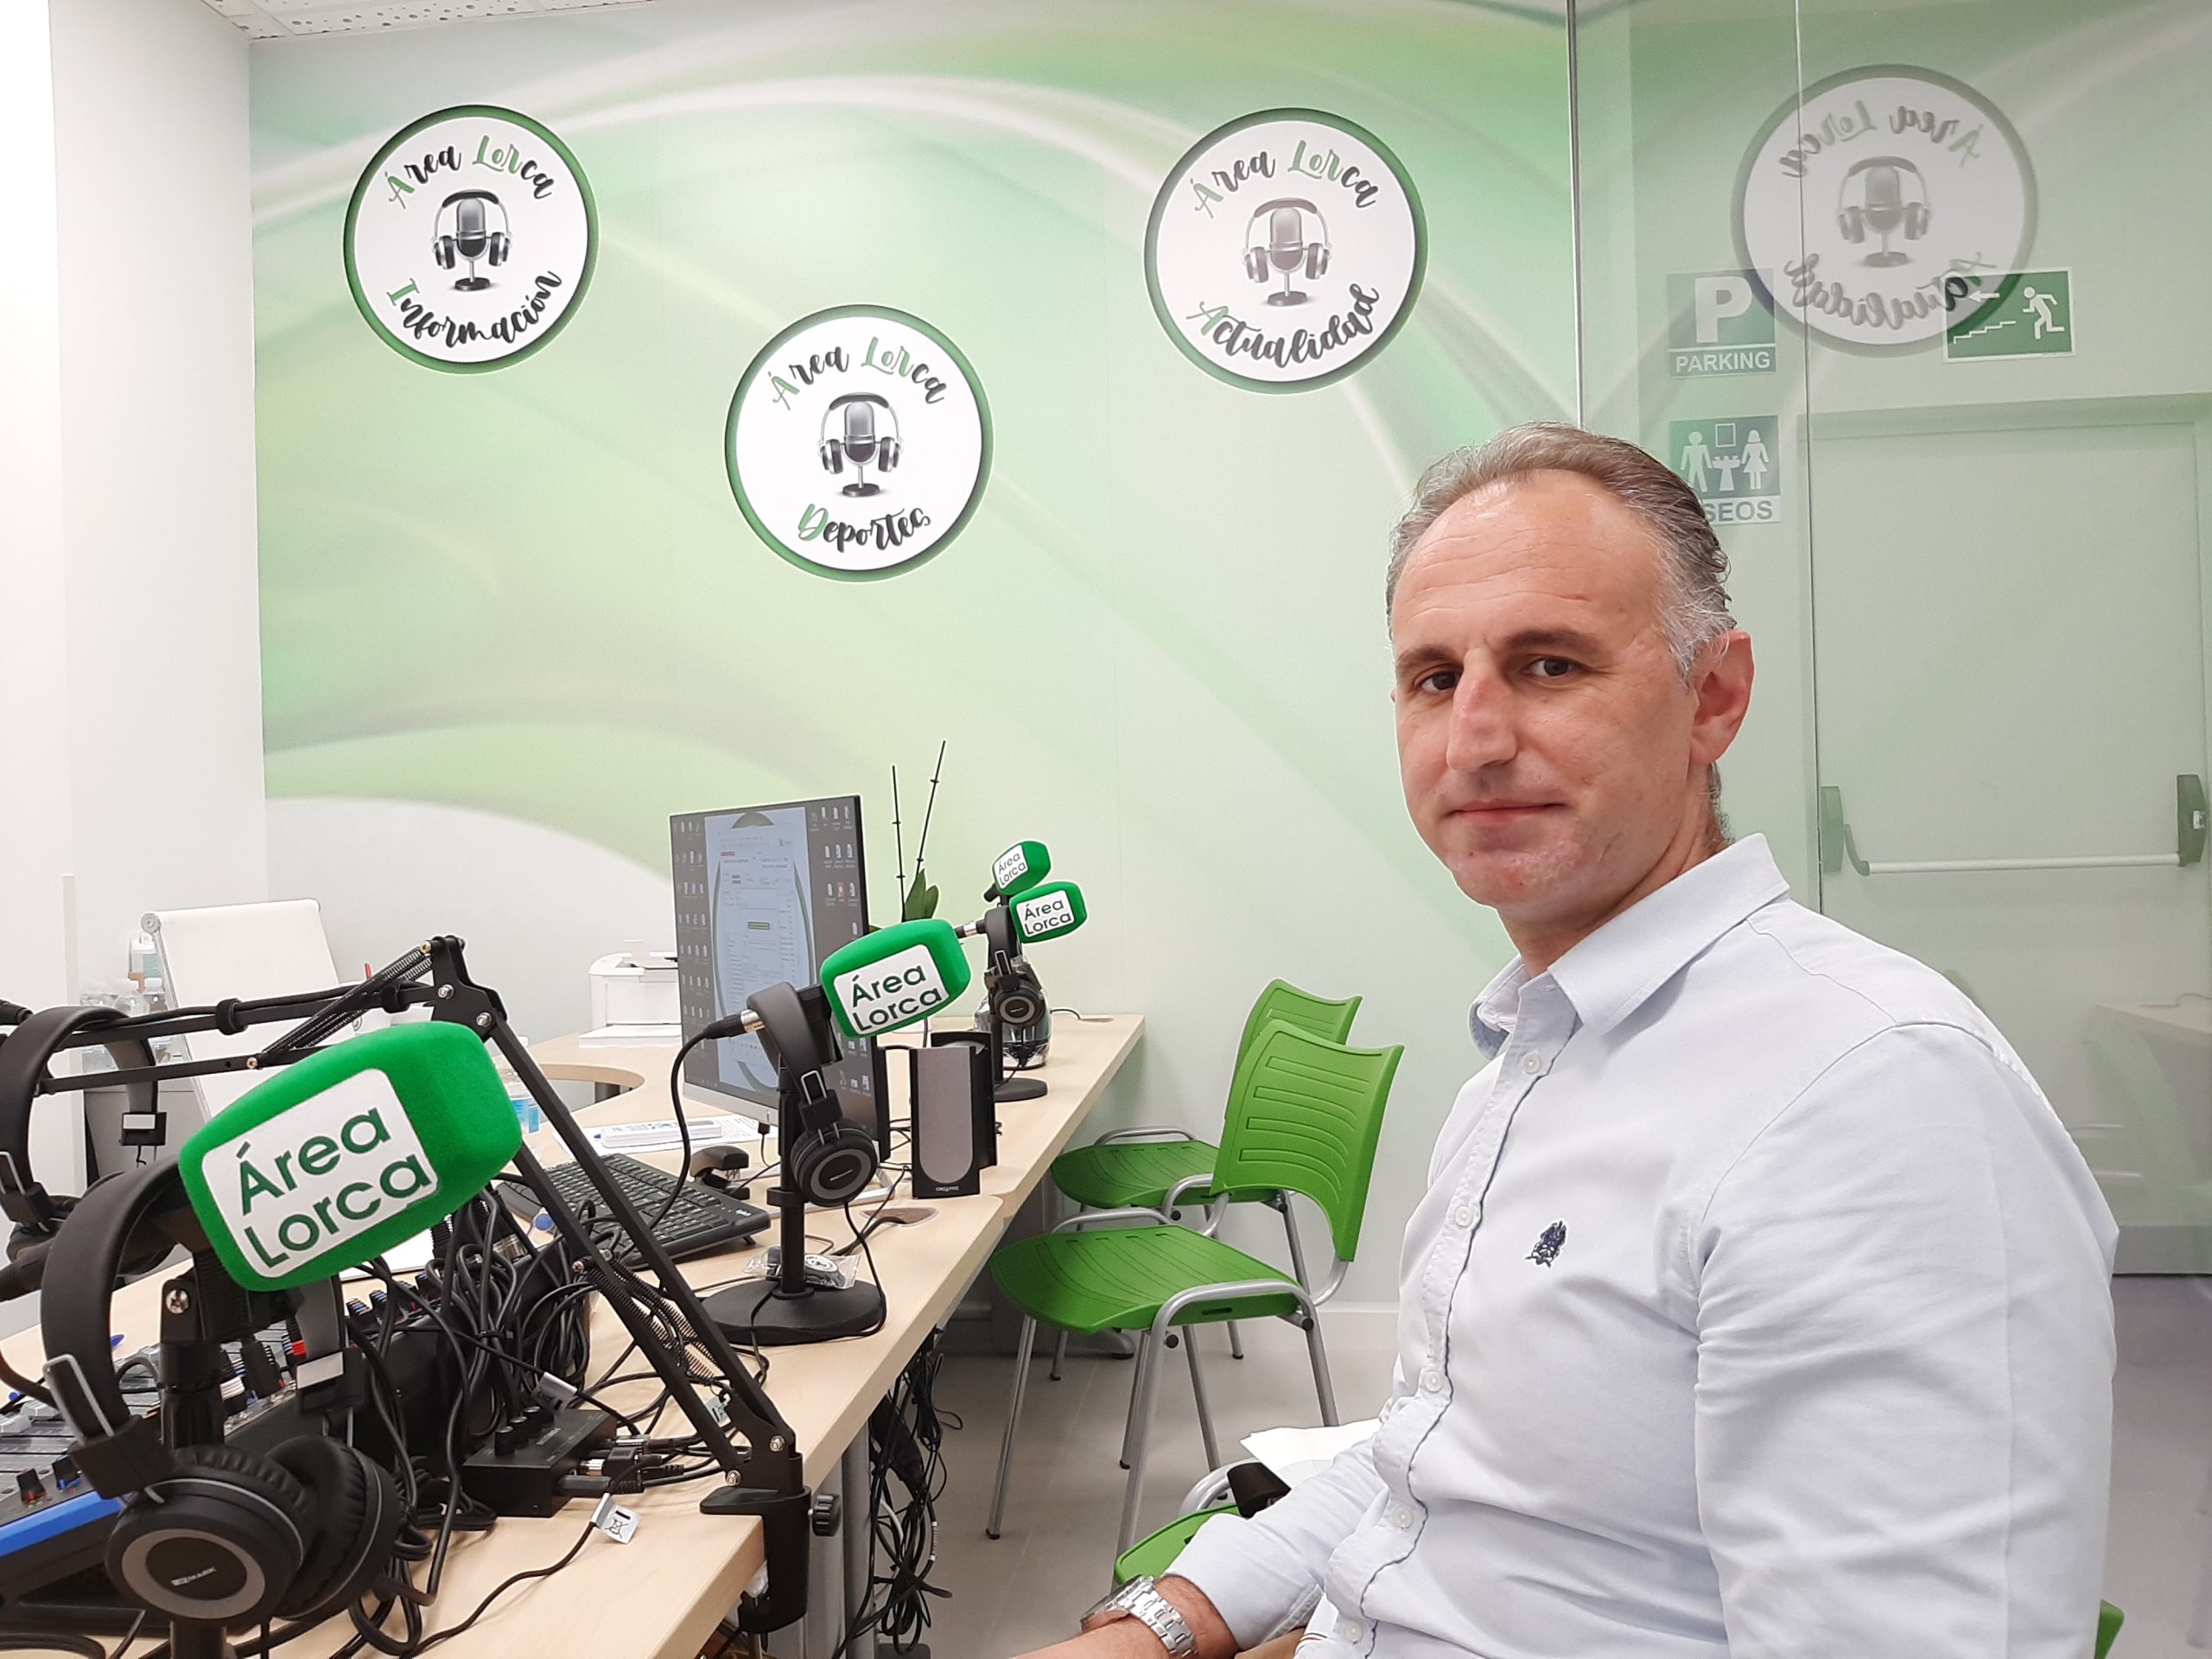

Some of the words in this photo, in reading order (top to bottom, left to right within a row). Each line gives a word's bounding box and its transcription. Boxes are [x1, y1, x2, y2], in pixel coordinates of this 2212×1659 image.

[385, 146, 461, 209] Área
[472, 135, 554, 199] Lorca
[1190, 151, 1275, 219] Área
[1287, 140, 1378, 207] Lorca
[386, 270, 562, 347] Información
[1185, 283, 1379, 368] Actualidad
[1694, 276, 1752, 343] P
[768, 346, 849, 410] Área
[861, 336, 946, 404] Lorca
[1675, 351, 1770, 372] PARKING
[798, 503, 931, 553] Deportes
[1702, 500, 1773, 522] SEOS
[1000, 862, 1027, 886] Lorca
[1025, 899, 1064, 921] Área
[1025, 913, 1071, 935] Lorca
[852, 964, 927, 1007] Área
[852, 988, 943, 1032] Lorca
[236, 1107, 391, 1217] Área
[245, 1154, 432, 1268] Lorca
